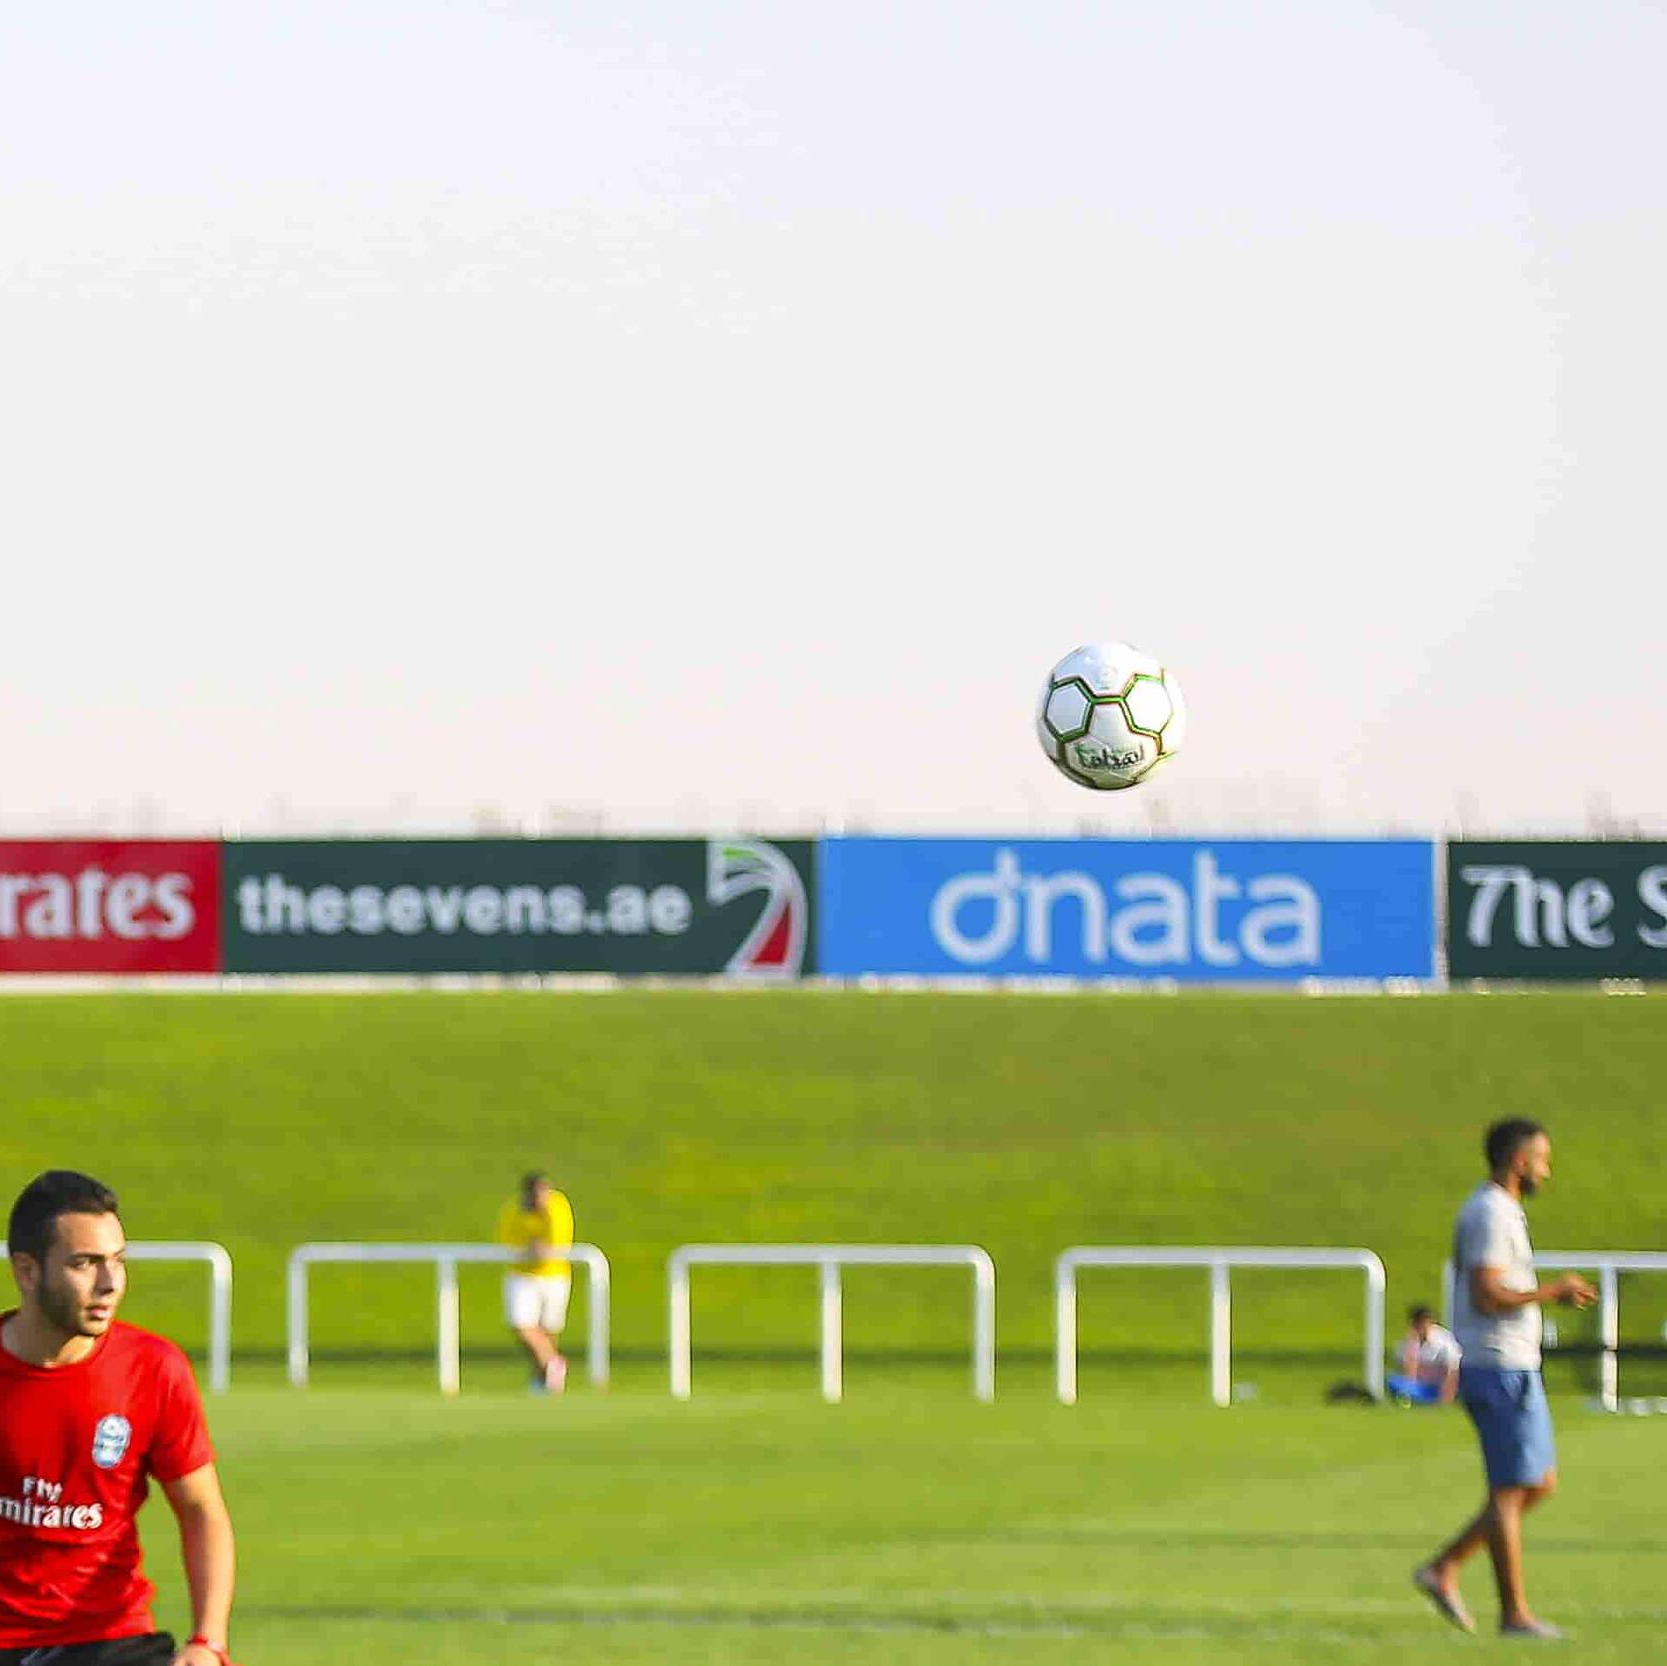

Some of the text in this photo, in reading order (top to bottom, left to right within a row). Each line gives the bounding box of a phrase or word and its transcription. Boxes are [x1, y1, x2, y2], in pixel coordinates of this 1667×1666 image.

[235, 873, 692, 937] thesevens.ae
[928, 846, 1323, 968] dnata
[1460, 864, 1616, 949] The
[22, 1476, 63, 1503] Fly
